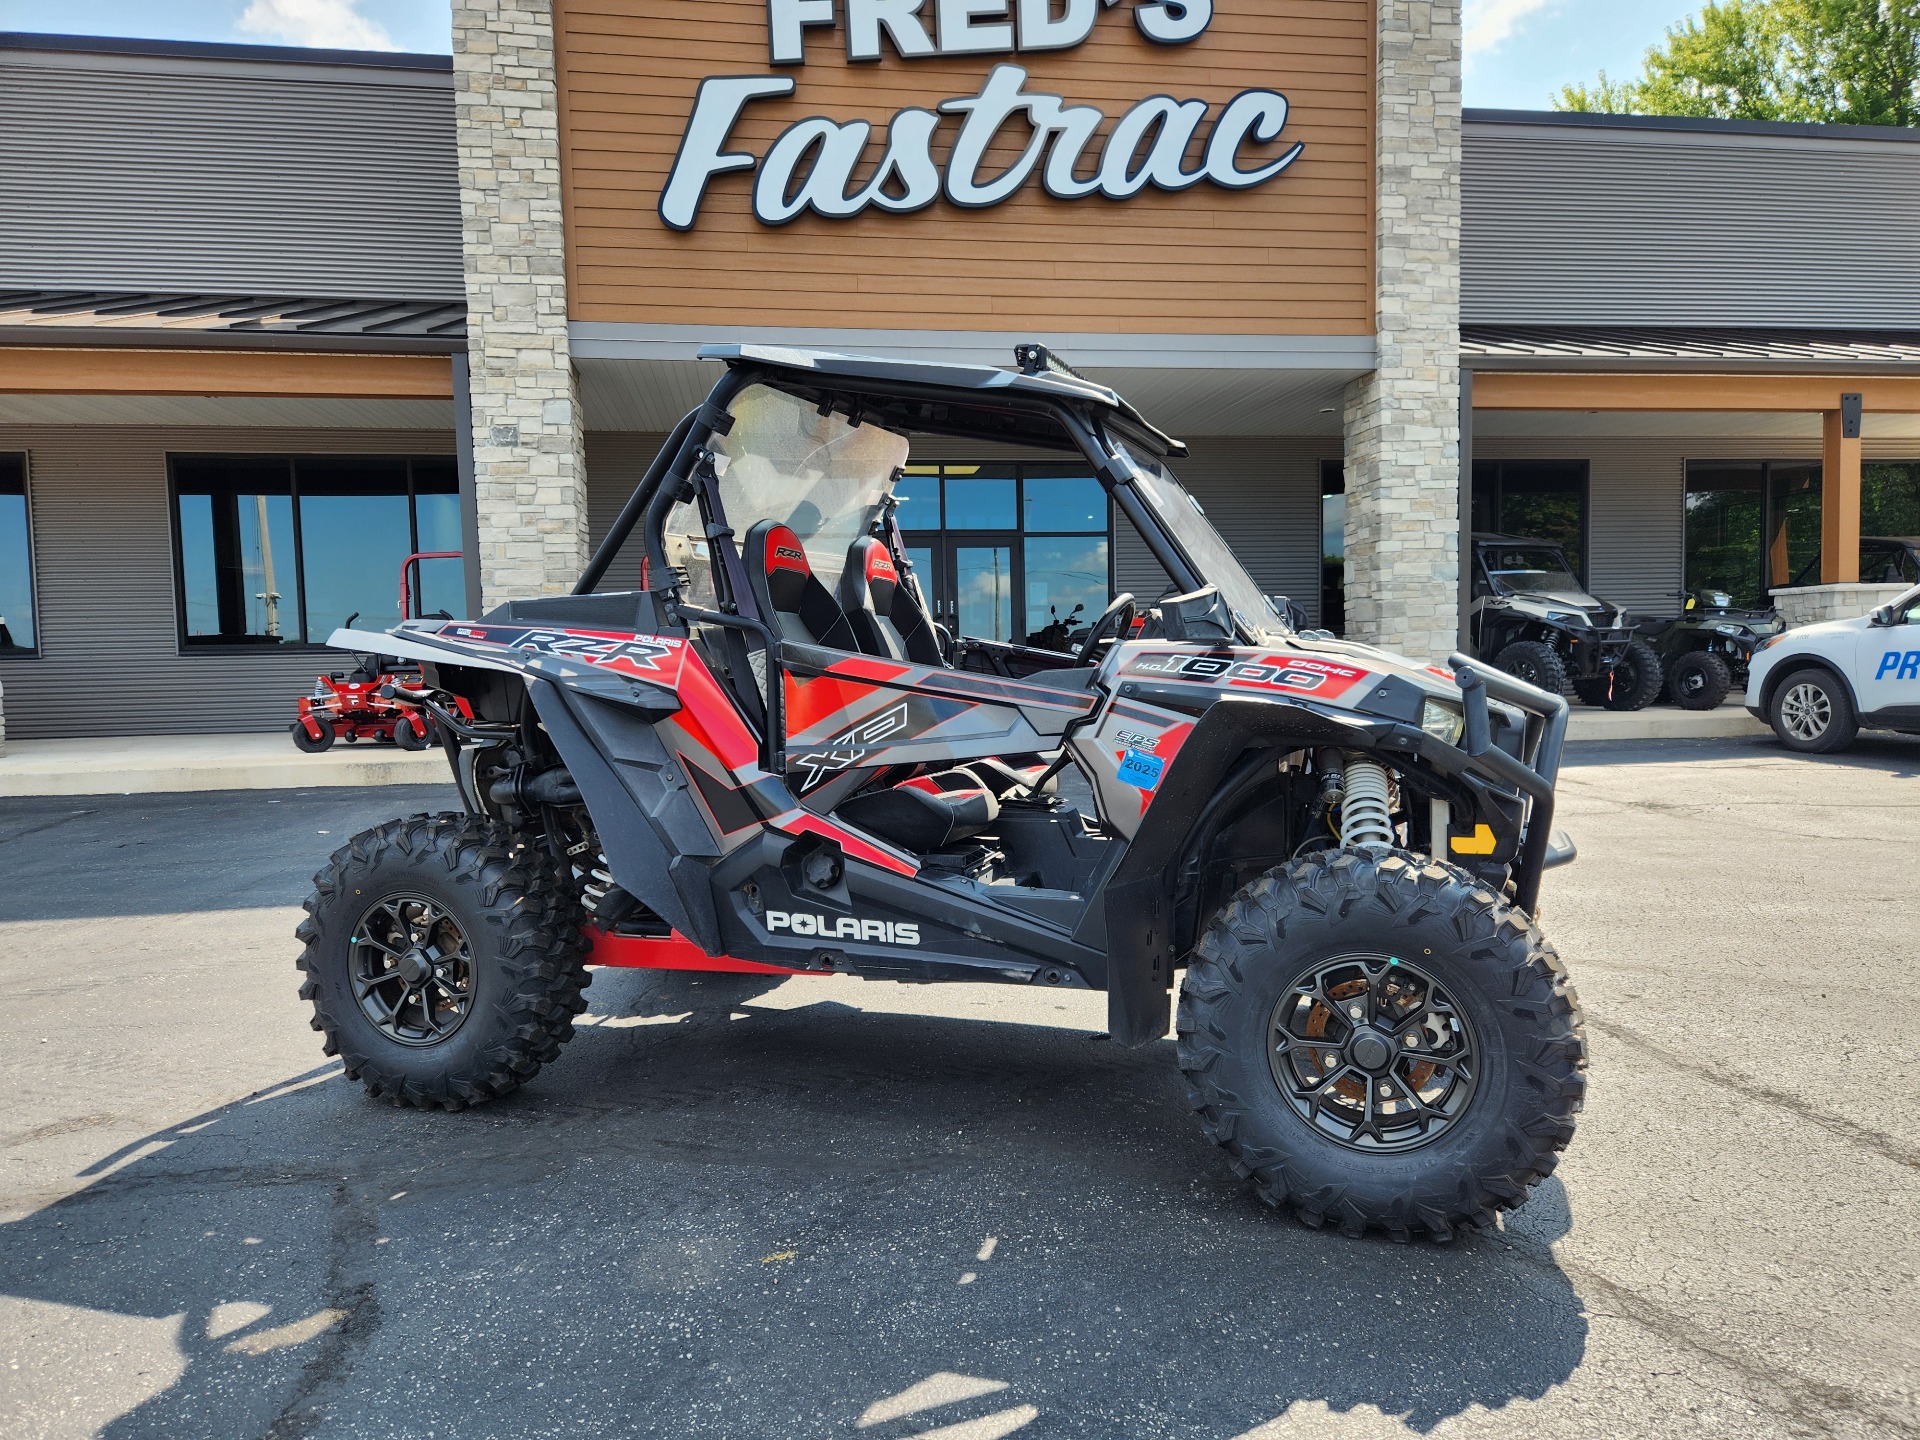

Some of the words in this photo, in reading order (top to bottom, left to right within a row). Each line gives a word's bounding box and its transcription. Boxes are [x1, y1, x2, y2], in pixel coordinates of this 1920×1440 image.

[769, 0, 1213, 65] FREDS
[658, 63, 1305, 231] Fastrac
[775, 546, 803, 560] RZR
[872, 559, 893, 572] RZR
[509, 630, 672, 671] RZR
[633, 634, 683, 648] POLARIS
[1162, 654, 1327, 689] 1000
[1287, 659, 1358, 677] DOHC
[1875, 651, 1920, 680] PR
[796, 702, 908, 793] XP
[1115, 729, 1161, 748] EPS
[1124, 758, 1160, 778] 2025
[766, 910, 921, 946] POLARIS
